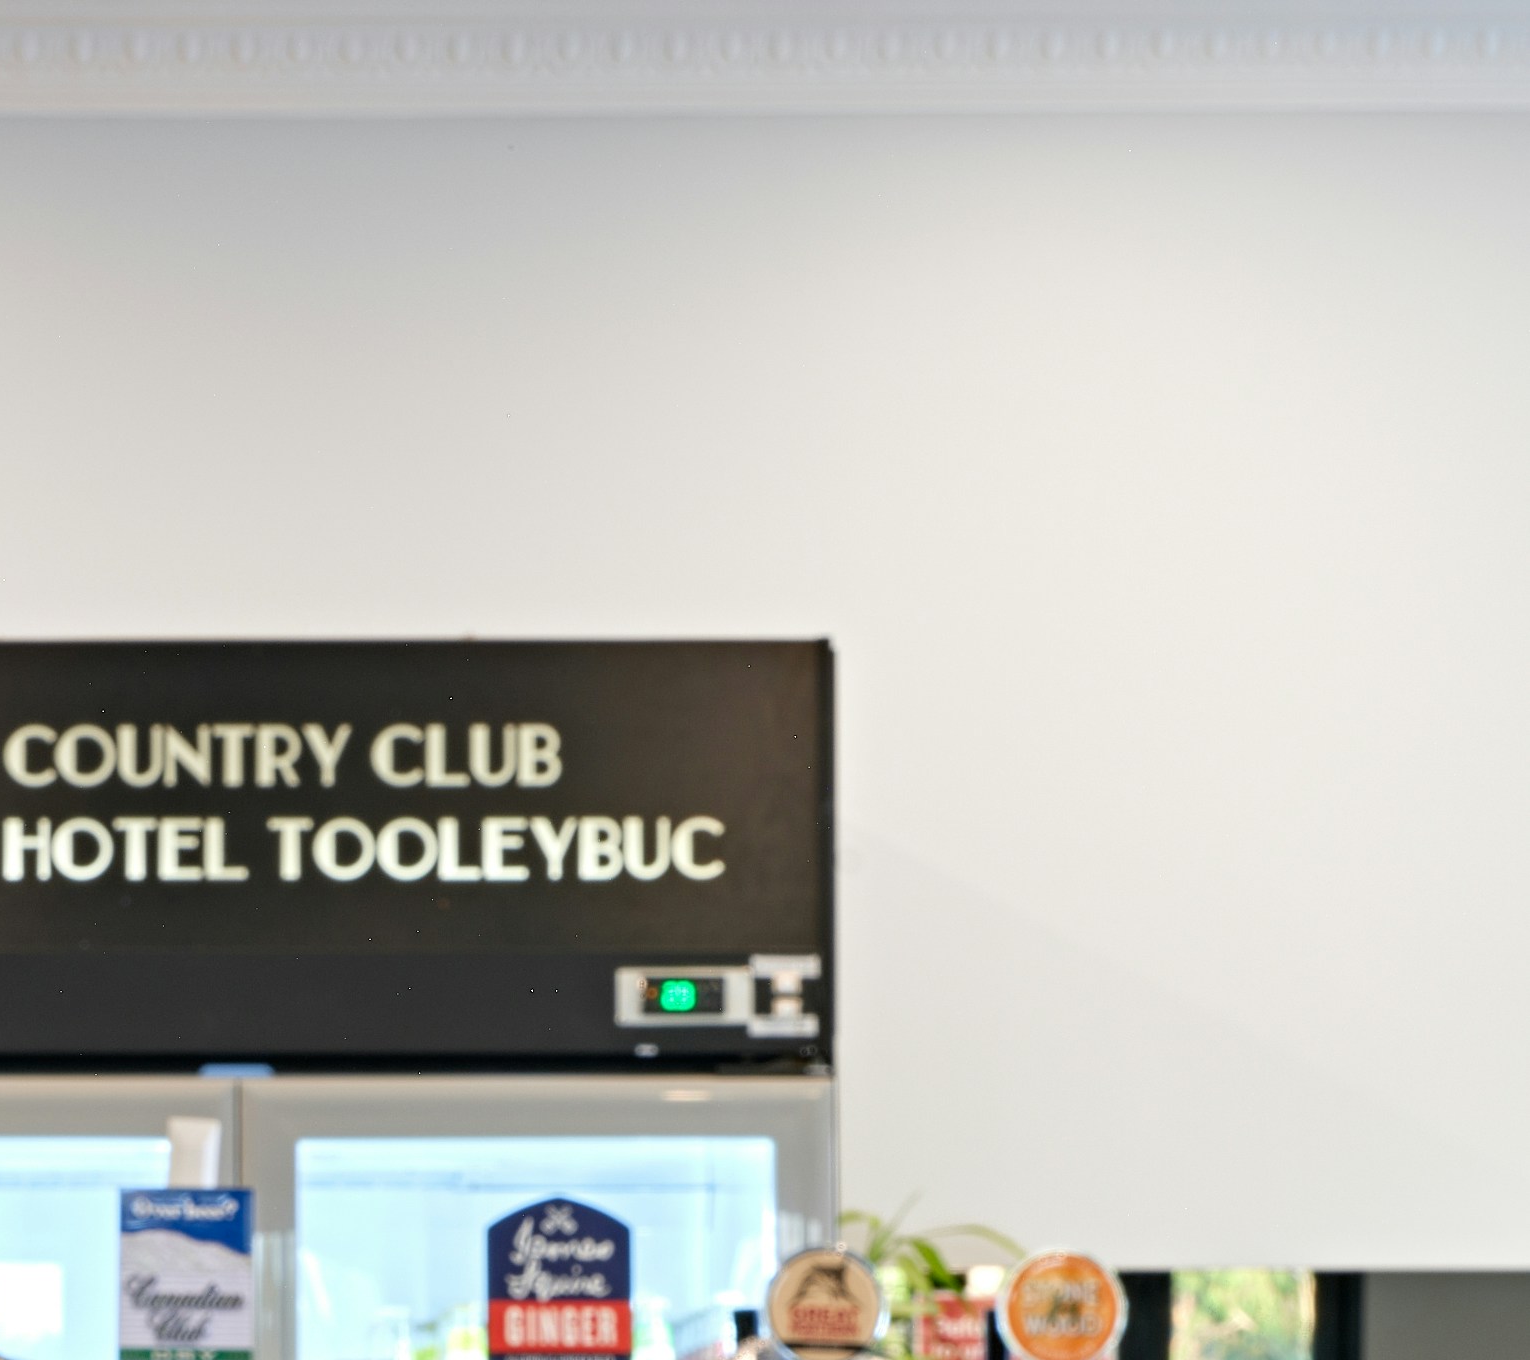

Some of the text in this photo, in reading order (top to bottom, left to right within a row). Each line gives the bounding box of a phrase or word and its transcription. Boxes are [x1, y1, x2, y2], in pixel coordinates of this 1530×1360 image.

[2, 723, 563, 788] COUNTRY CLUB
[2, 816, 726, 882] HOTEL TOOLEYBUC
[503, 1304, 619, 1349] GINGER
